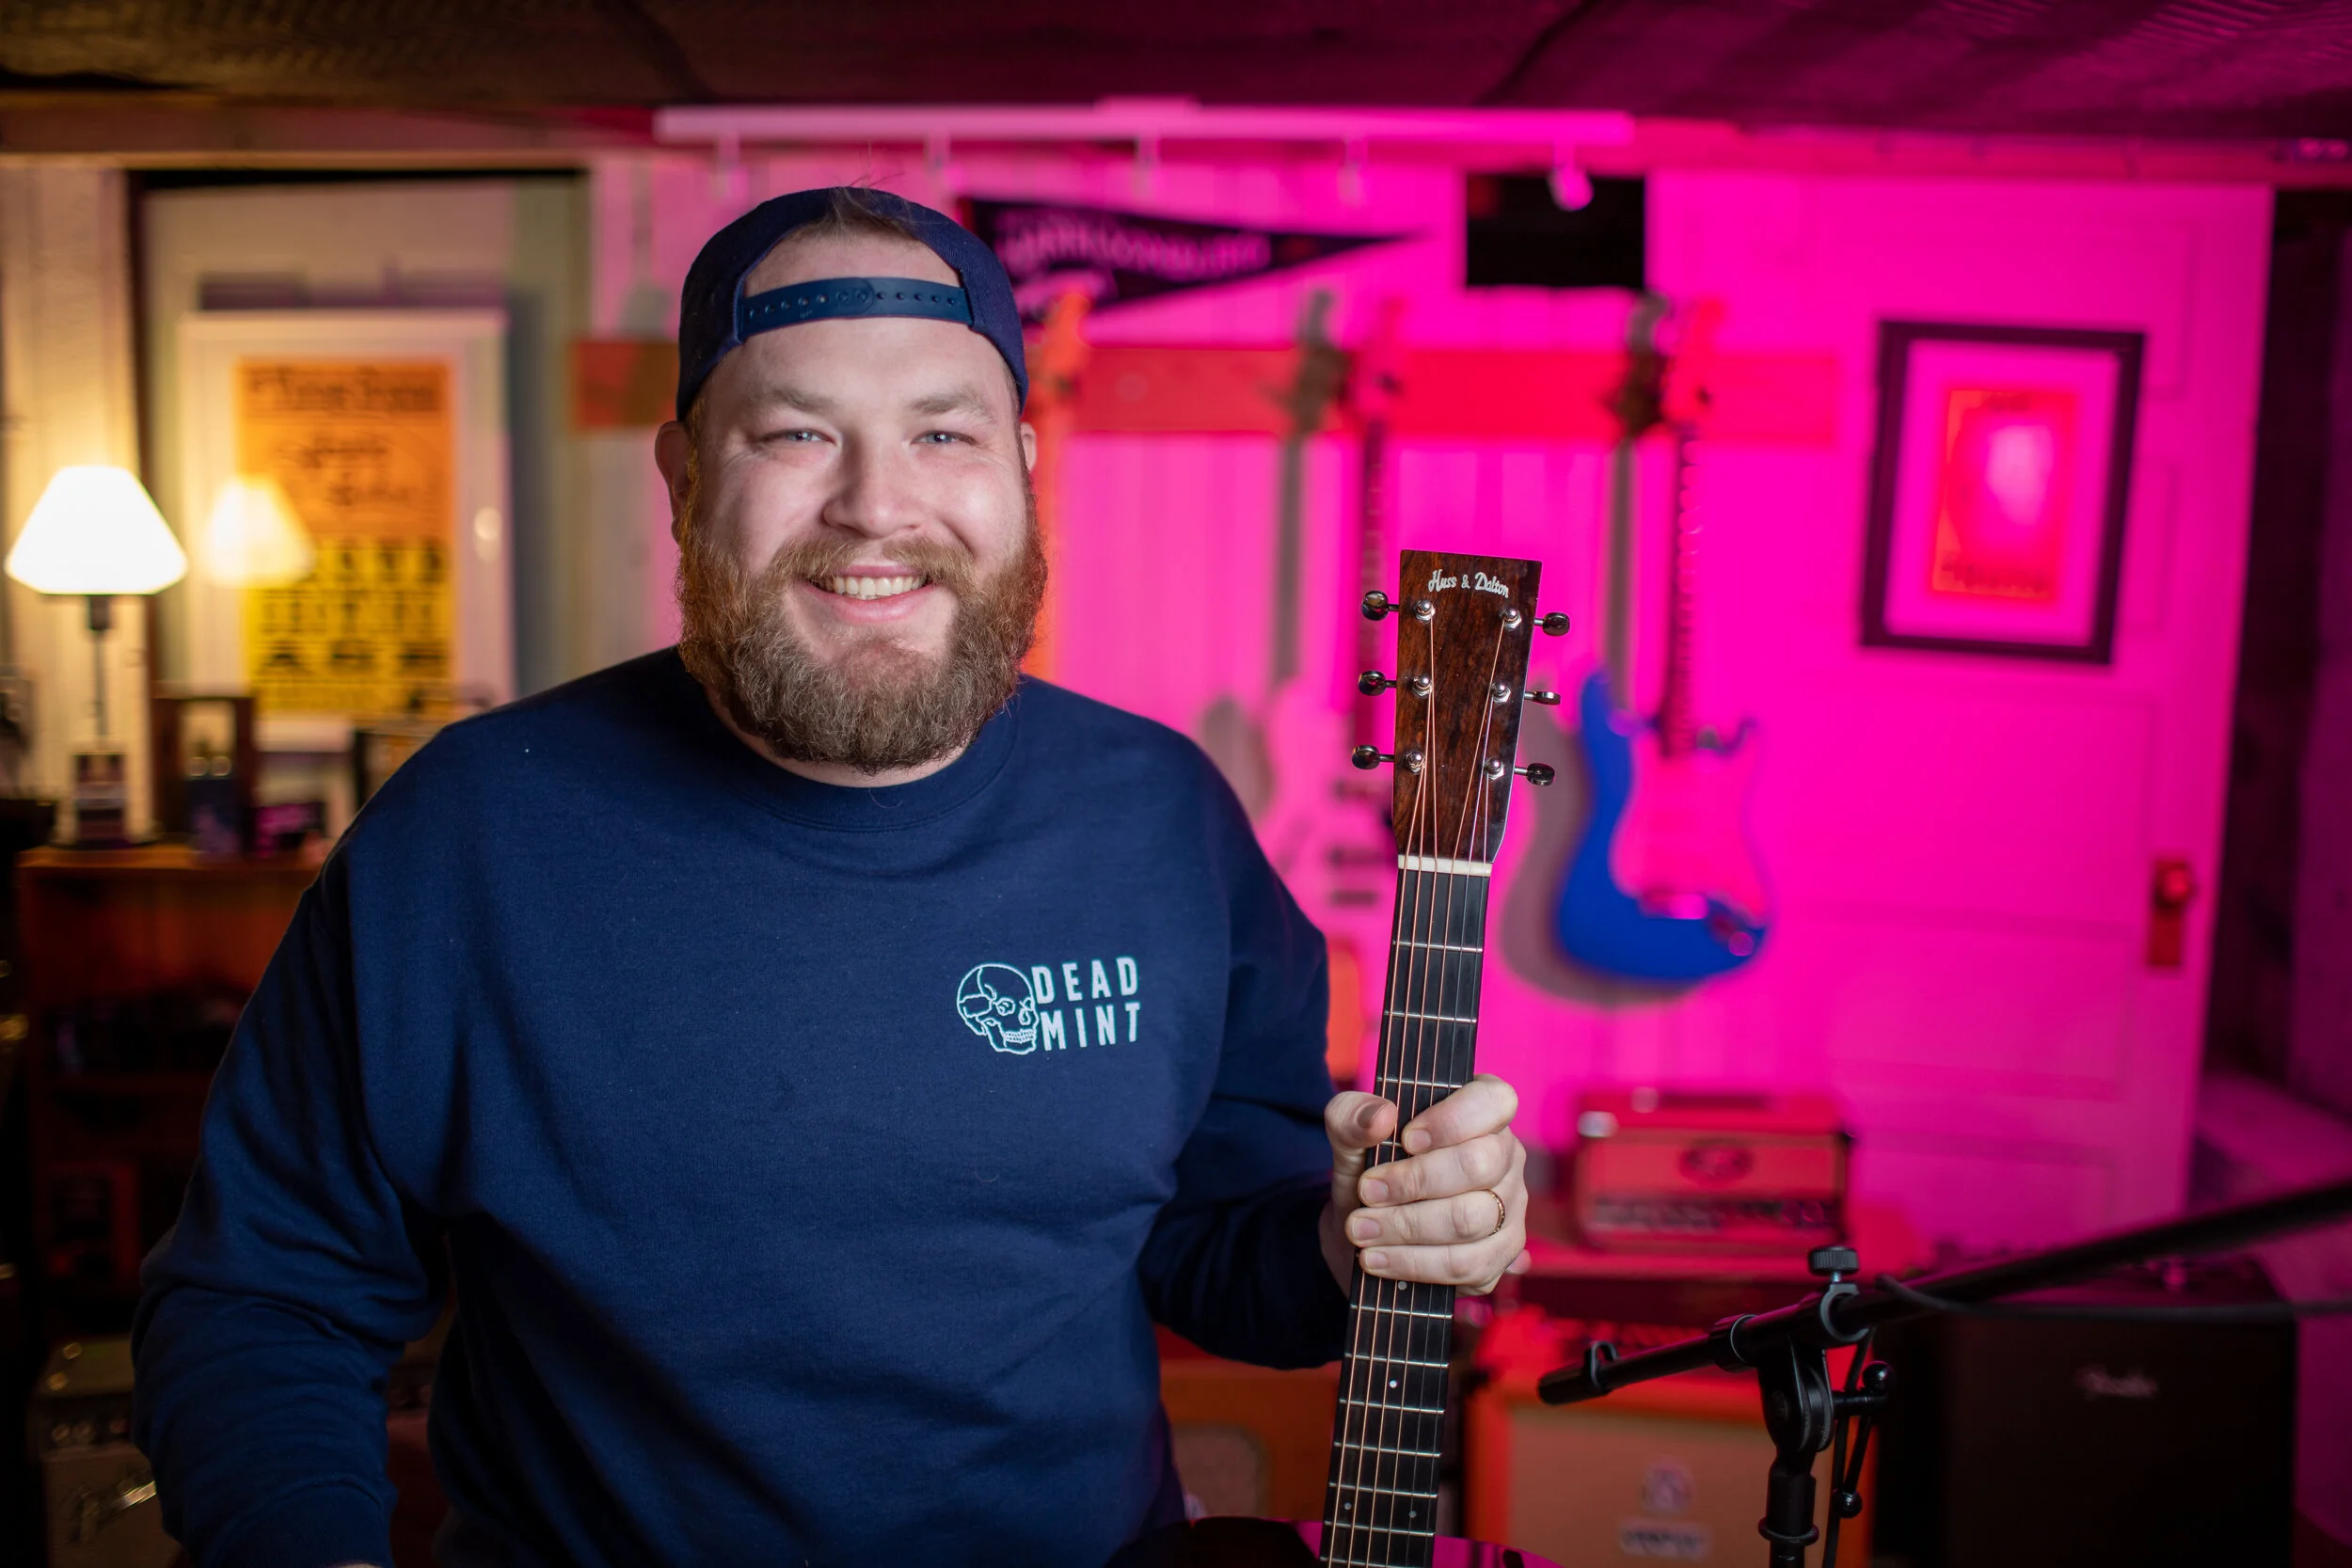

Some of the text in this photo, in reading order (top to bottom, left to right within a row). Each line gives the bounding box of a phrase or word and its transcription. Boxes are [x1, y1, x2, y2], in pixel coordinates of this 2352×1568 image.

[1428, 569, 1509, 599] Huss & Dalton
[1031, 957, 1138, 1005] DEAD
[1040, 1002, 1141, 1052] MINT
